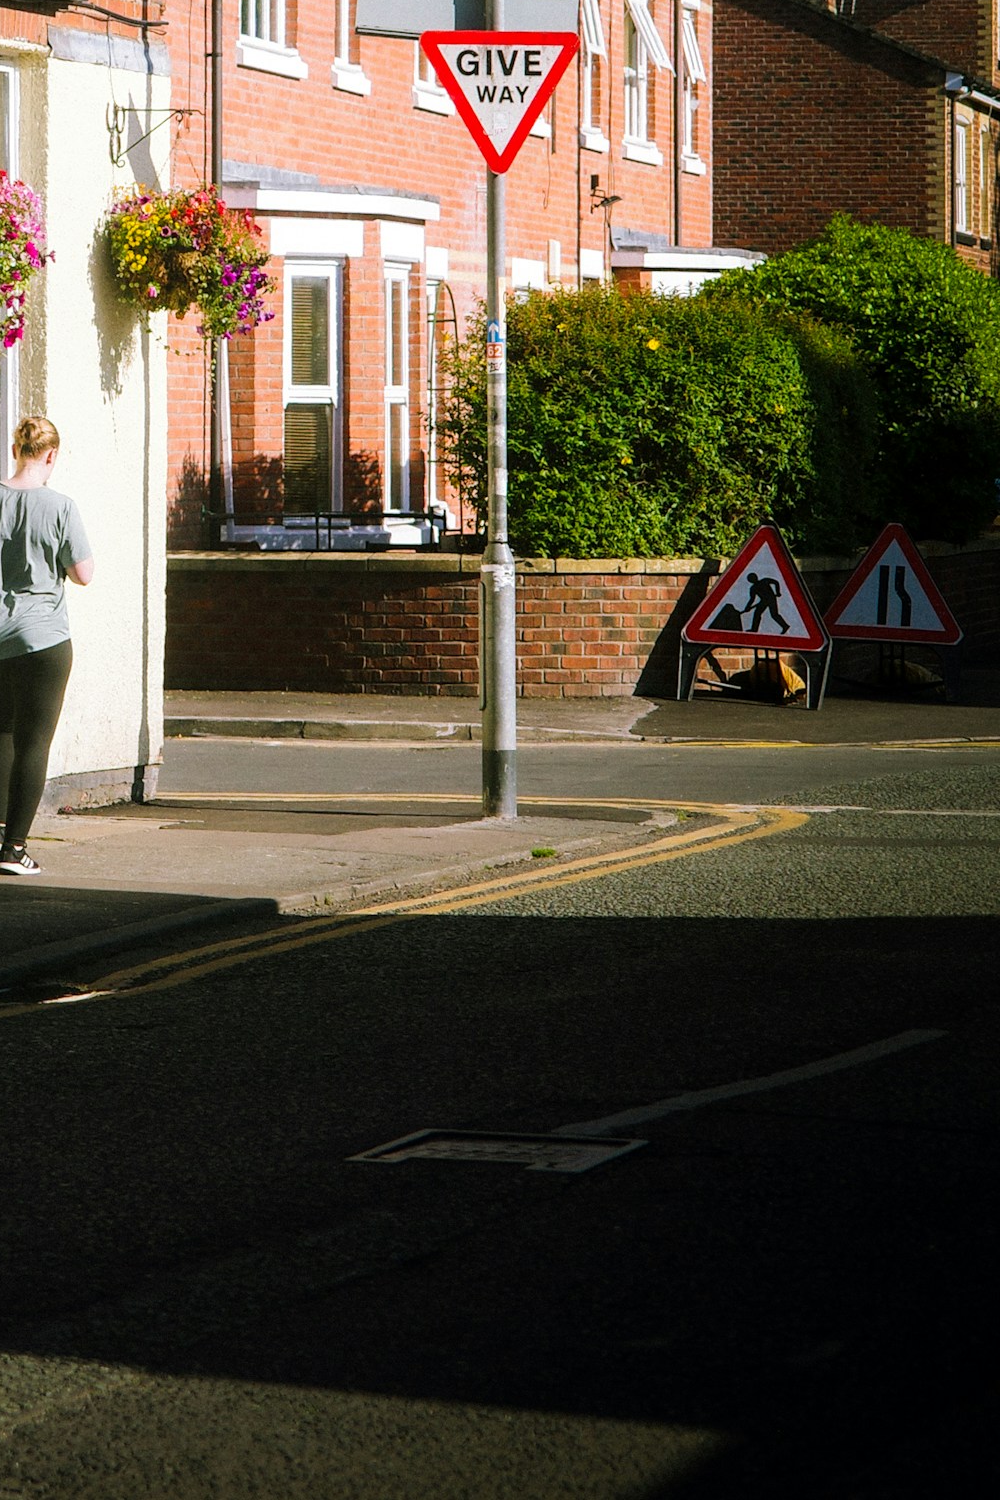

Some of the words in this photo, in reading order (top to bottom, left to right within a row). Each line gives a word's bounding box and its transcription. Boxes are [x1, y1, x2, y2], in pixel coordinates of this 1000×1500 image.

[456, 50, 542, 77] GIVE
[476, 85, 529, 103] WAY
[487, 345, 503, 357] 62
